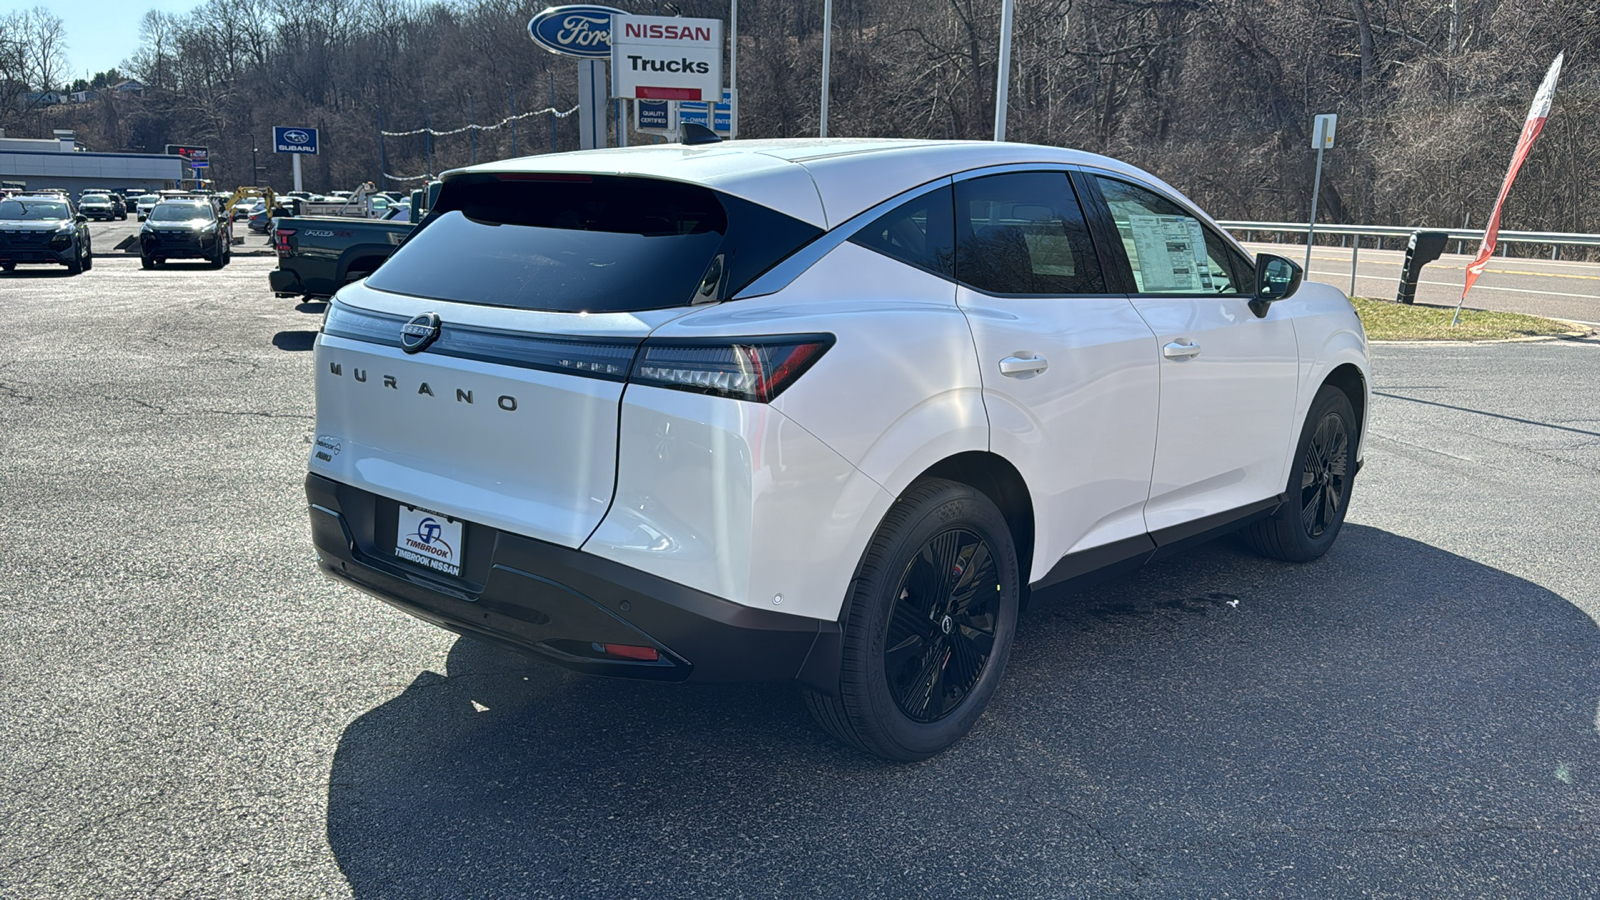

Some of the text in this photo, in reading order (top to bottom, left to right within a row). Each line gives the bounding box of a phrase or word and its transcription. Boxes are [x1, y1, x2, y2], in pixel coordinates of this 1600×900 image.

[557, 15, 611, 46] For
[625, 23, 711, 42] NISSAN
[627, 54, 710, 74] Trucks
[278, 144, 315, 152] SUBARU
[329, 361, 519, 412] MURANO
[405, 537, 449, 559] TIMBROOK
[394, 547, 460, 577] TIMBROOK NISSAN
